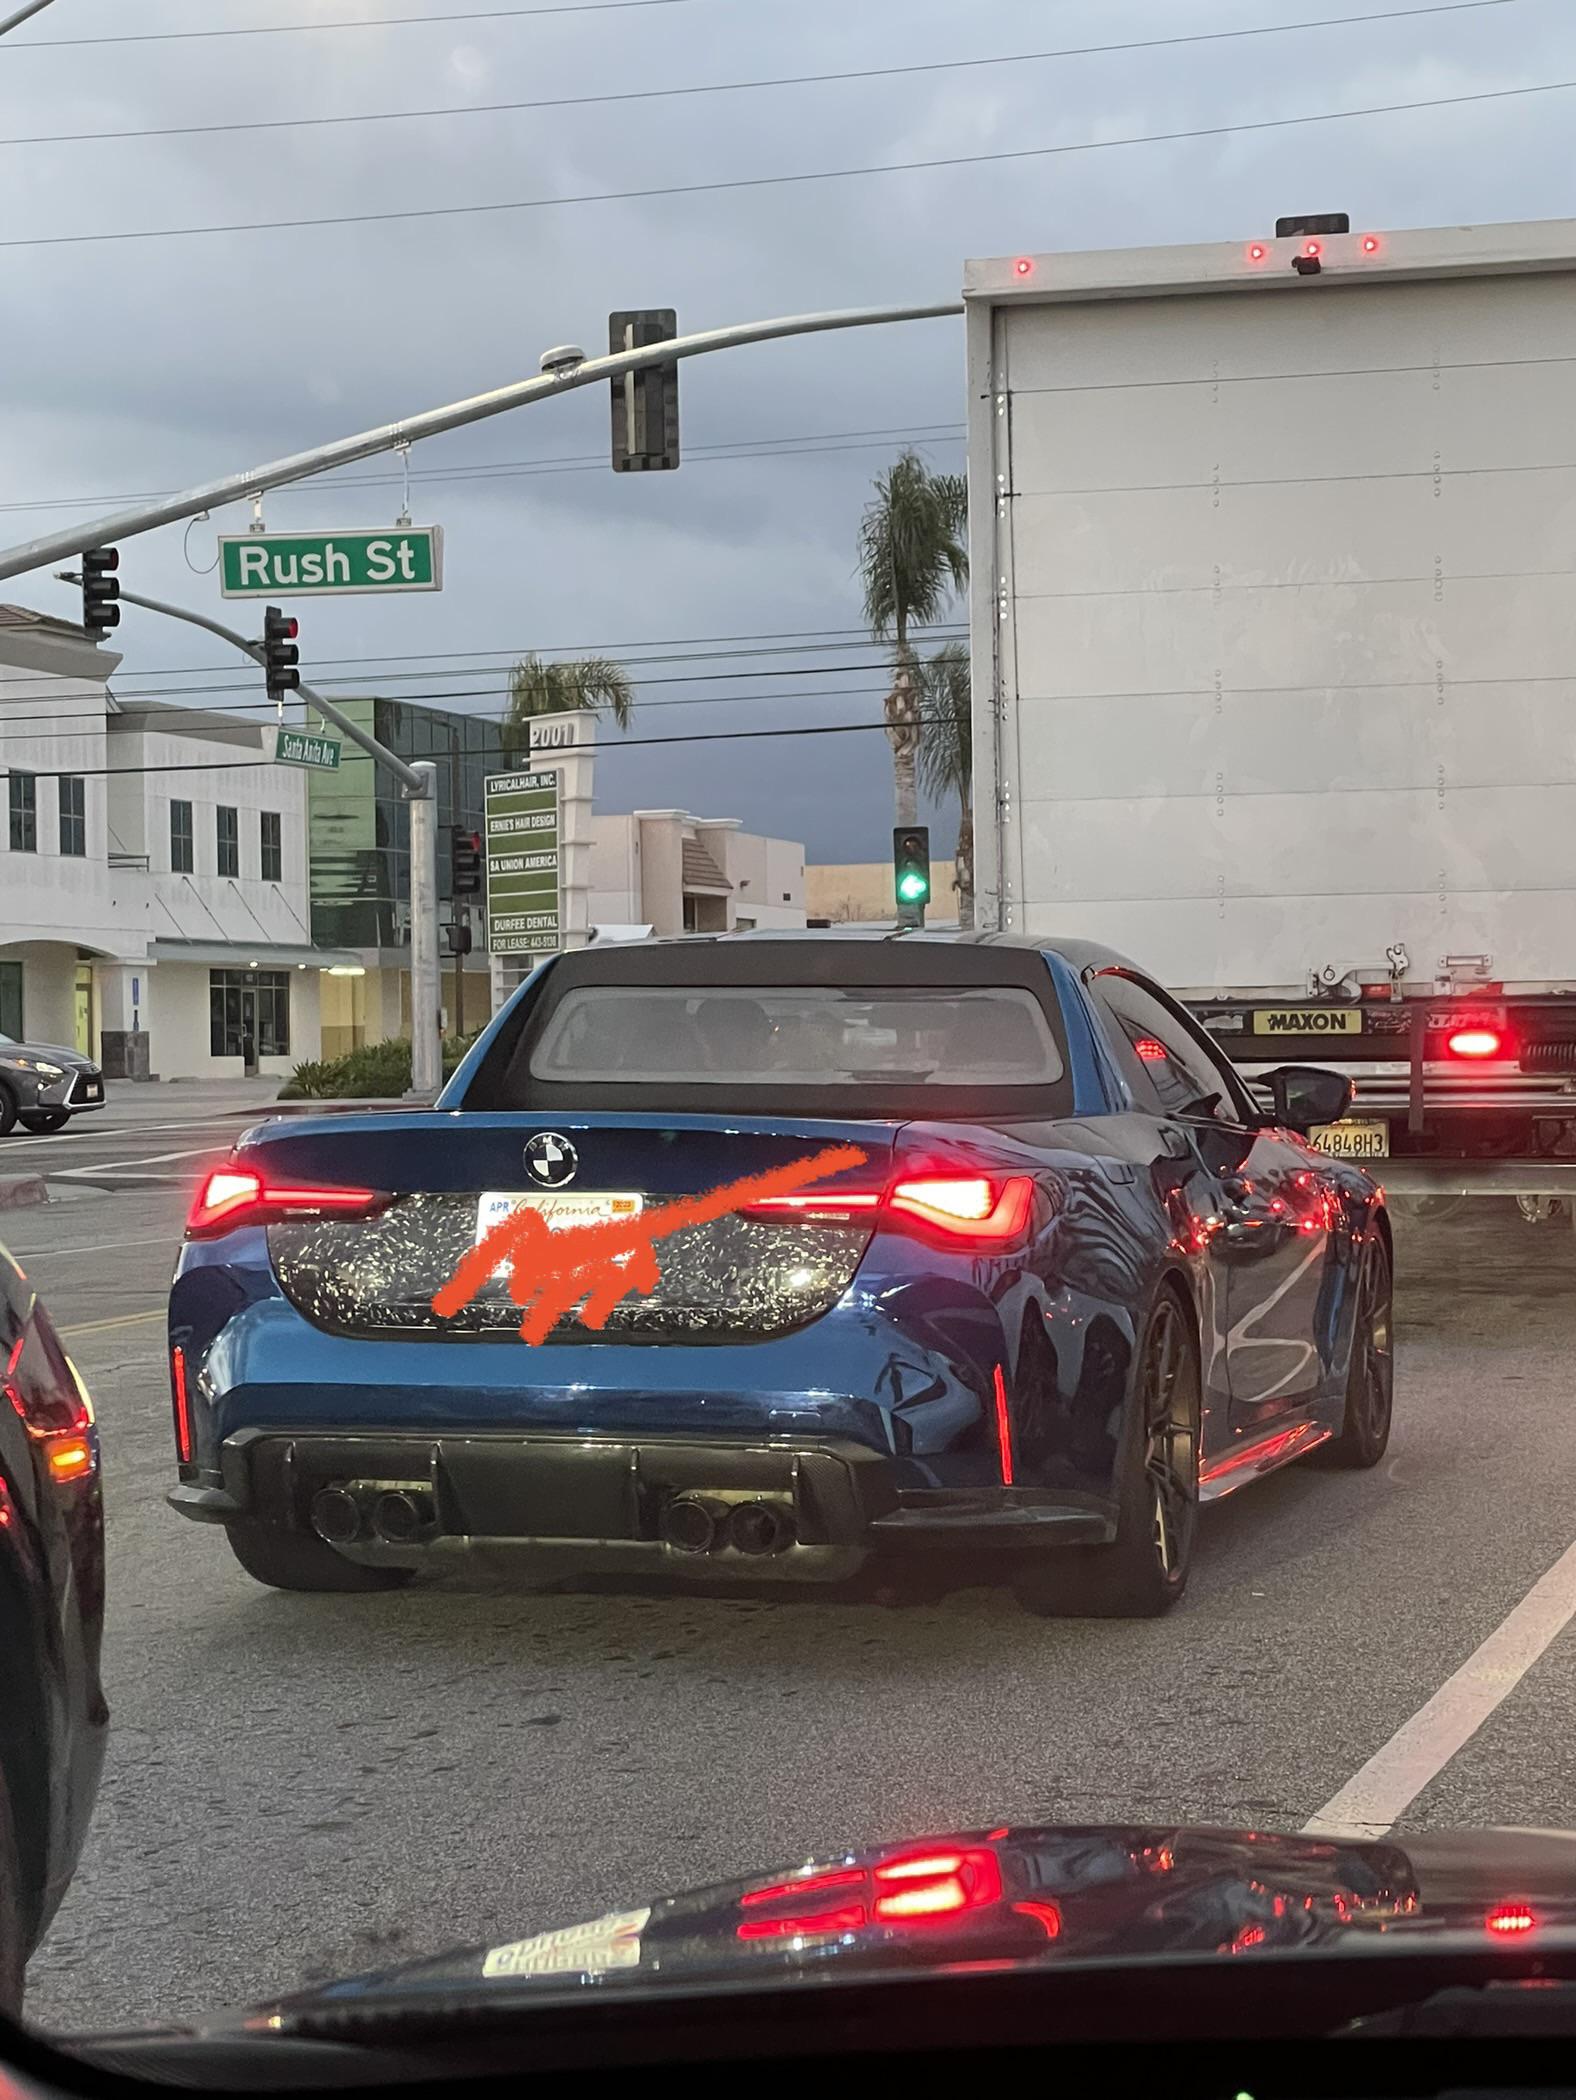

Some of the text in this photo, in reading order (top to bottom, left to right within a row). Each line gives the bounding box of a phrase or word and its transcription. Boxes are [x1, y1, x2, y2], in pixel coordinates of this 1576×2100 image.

[238, 539, 416, 585] Rush St
[531, 723, 574, 748] 2001
[282, 735, 335, 766] Santa Anita Ave
[540, 774, 556, 787] INC.
[515, 817, 531, 830] HAIR
[531, 814, 556, 828] DESIGN
[501, 858, 524, 871] UNION
[525, 855, 557, 869] AMERICA
[494, 915, 558, 931] DURFEE DENTAL
[492, 939, 507, 950] FOR
[507, 937, 530, 949] LEASE:
[1268, 1013, 1346, 1031] MAXON
[1313, 1133, 1383, 1153] 64848H3
[489, 1201, 510, 1212] APR
[513, 1198, 602, 1223] Clifornia
